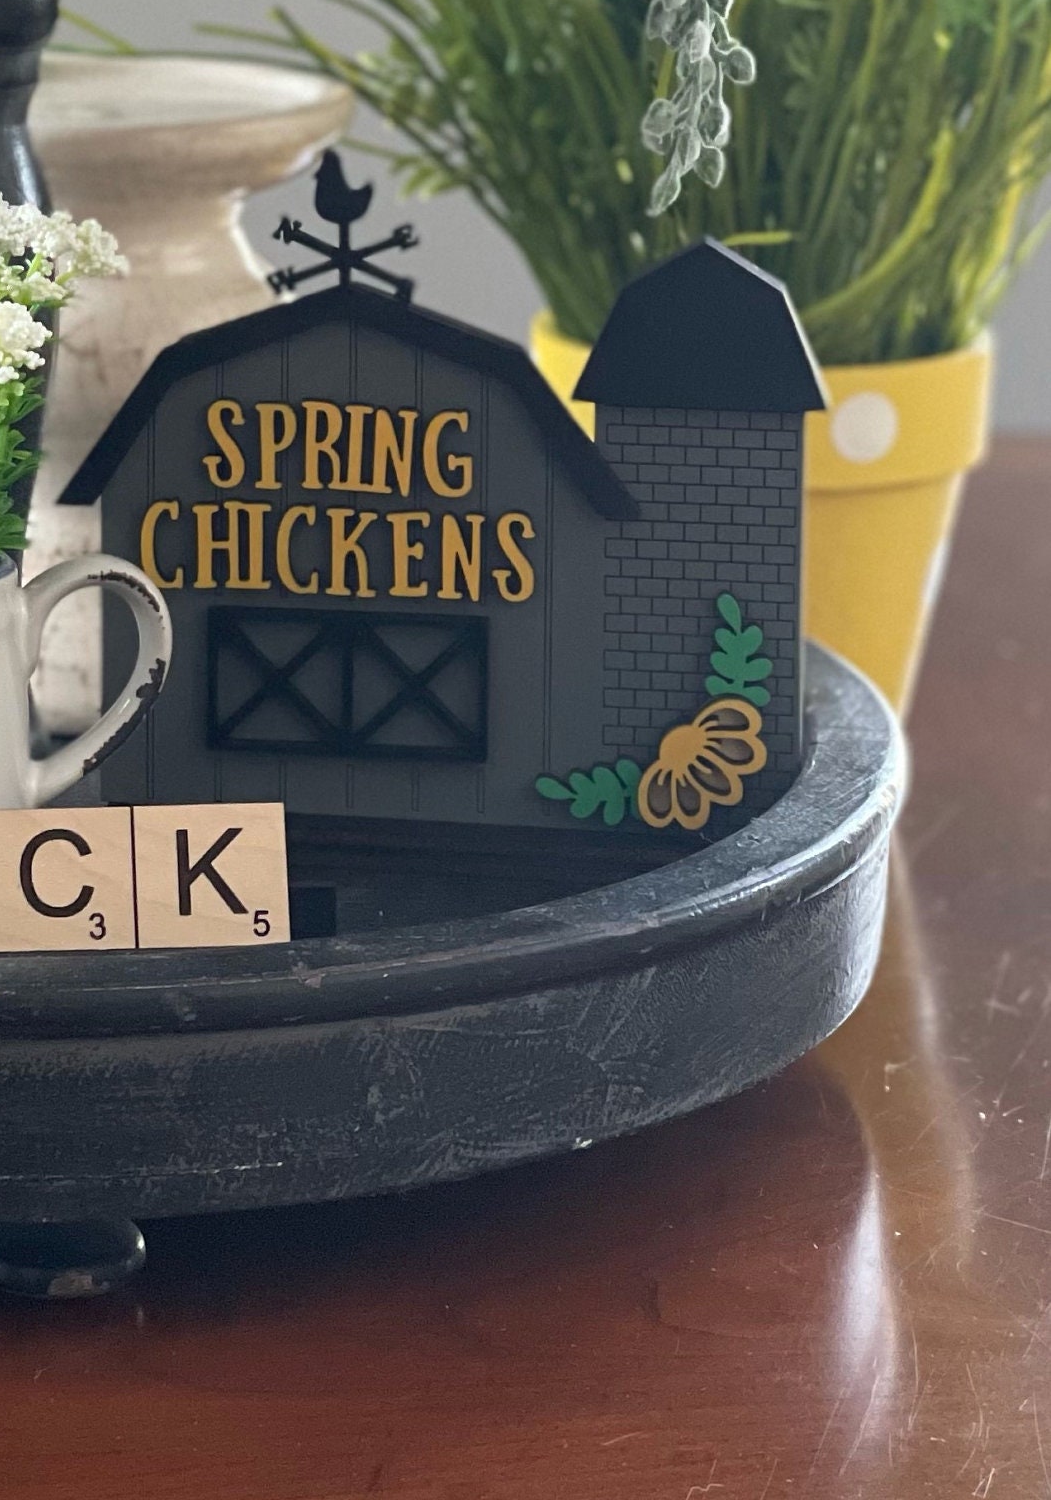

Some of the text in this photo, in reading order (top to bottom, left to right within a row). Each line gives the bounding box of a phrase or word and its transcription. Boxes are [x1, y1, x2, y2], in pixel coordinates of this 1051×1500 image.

[202, 399, 474, 498] SPRING
[139, 499, 537, 602] CHICKENS
[88, 912, 107, 941] 3
[252, 910, 271, 937] 5
